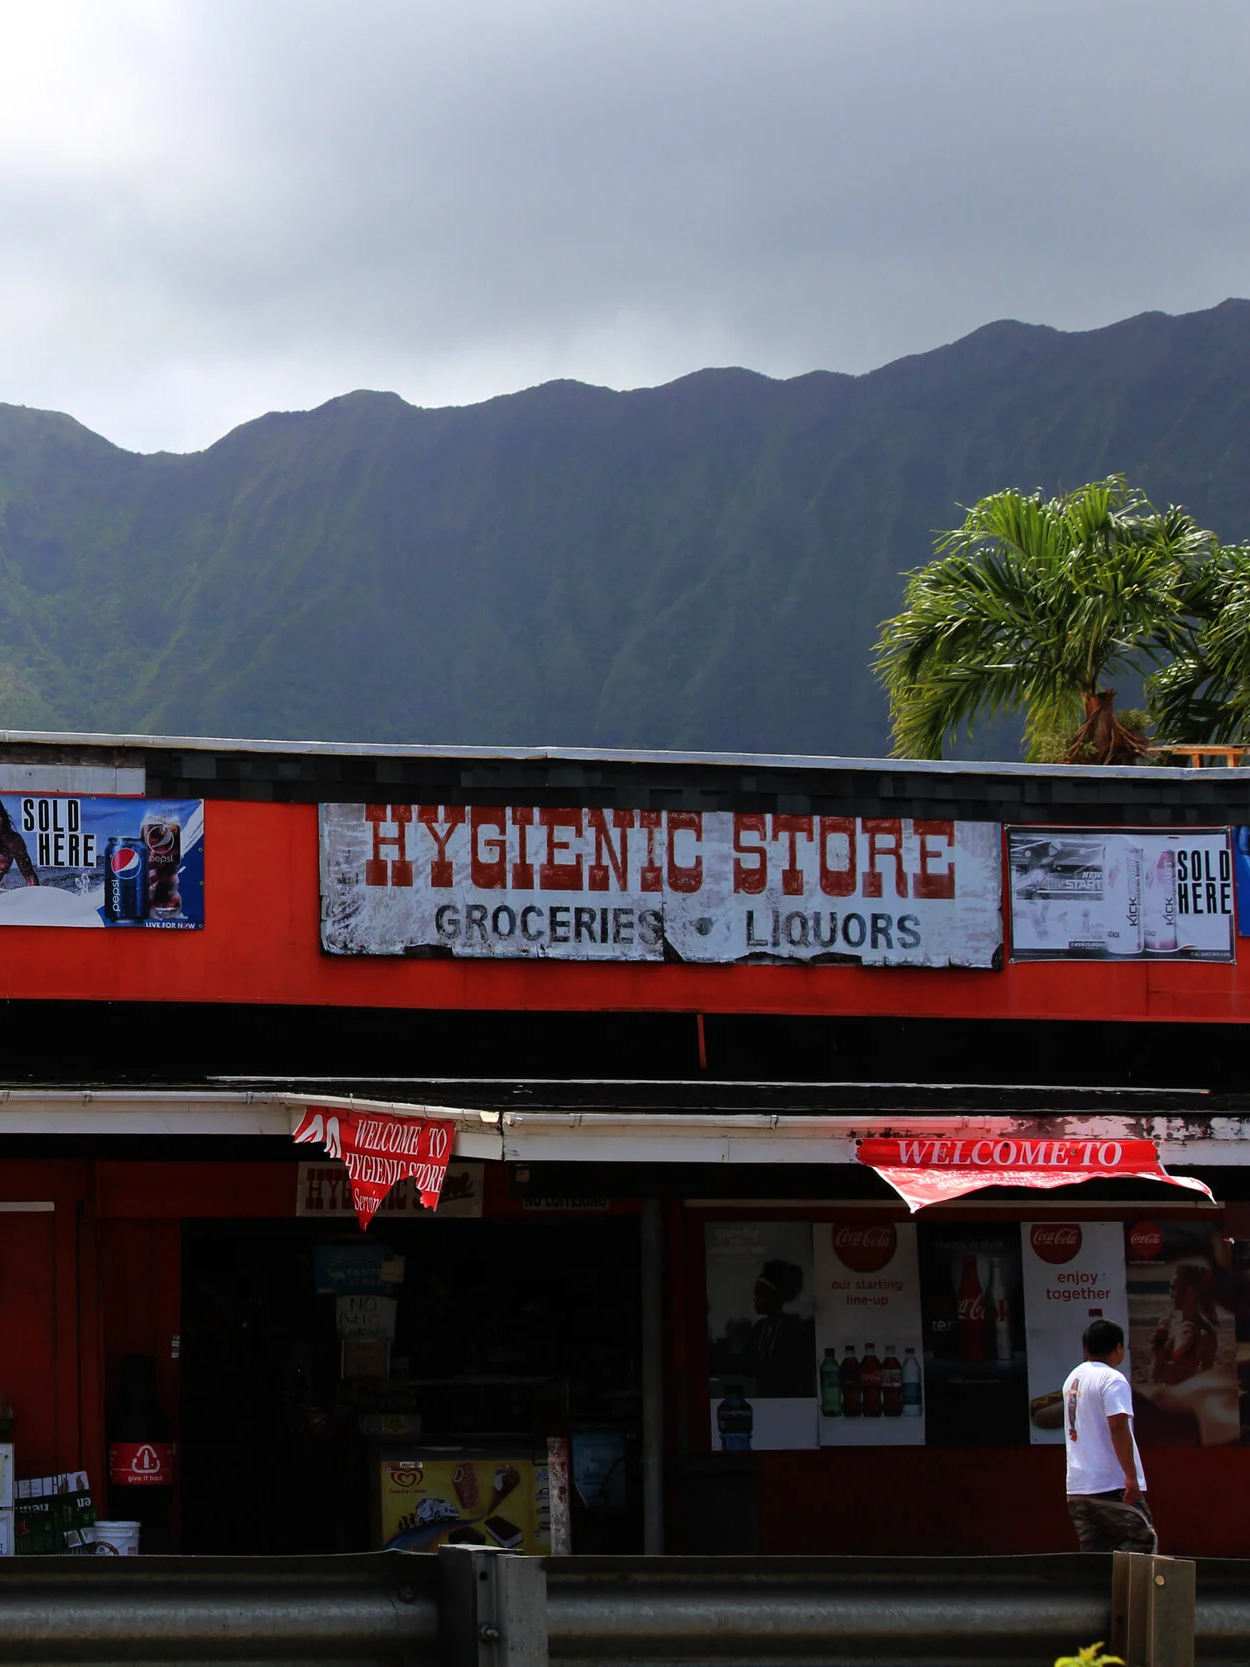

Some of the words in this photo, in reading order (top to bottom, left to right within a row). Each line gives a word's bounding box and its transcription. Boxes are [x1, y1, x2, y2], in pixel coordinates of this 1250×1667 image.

[23, 798, 79, 832] SOLD
[38, 834, 96, 867] HERE
[365, 803, 703, 894] HYGIENIC
[733, 811, 955, 899] STORE
[1177, 850, 1231, 882] SOLD
[111, 879, 121, 912] pepsi
[1178, 882, 1232, 915] HERE
[435, 904, 663, 945] GROCERIES
[745, 910, 921, 949] LIQUORS
[354, 1119, 421, 1156] WELCOME
[428, 1128, 447, 1159] TO
[897, 1140, 1075, 1166] WELCOME
[1078, 1141, 1123, 1166] TO
[354, 1187, 382, 1213] Servin
[835, 1226, 892, 1249] Coca-Cola
[1033, 1228, 1080, 1246] Coca-Cola
[1130, 1233, 1161, 1244] Coca-Cola
[831, 1280, 851, 1290] our
[855, 1280, 903, 1292] starting
[1057, 1271, 1098, 1285] enjoy
[846, 1294, 889, 1306] line-up
[1046, 1287, 1111, 1301] together
[127, 1475, 142, 1483] give
